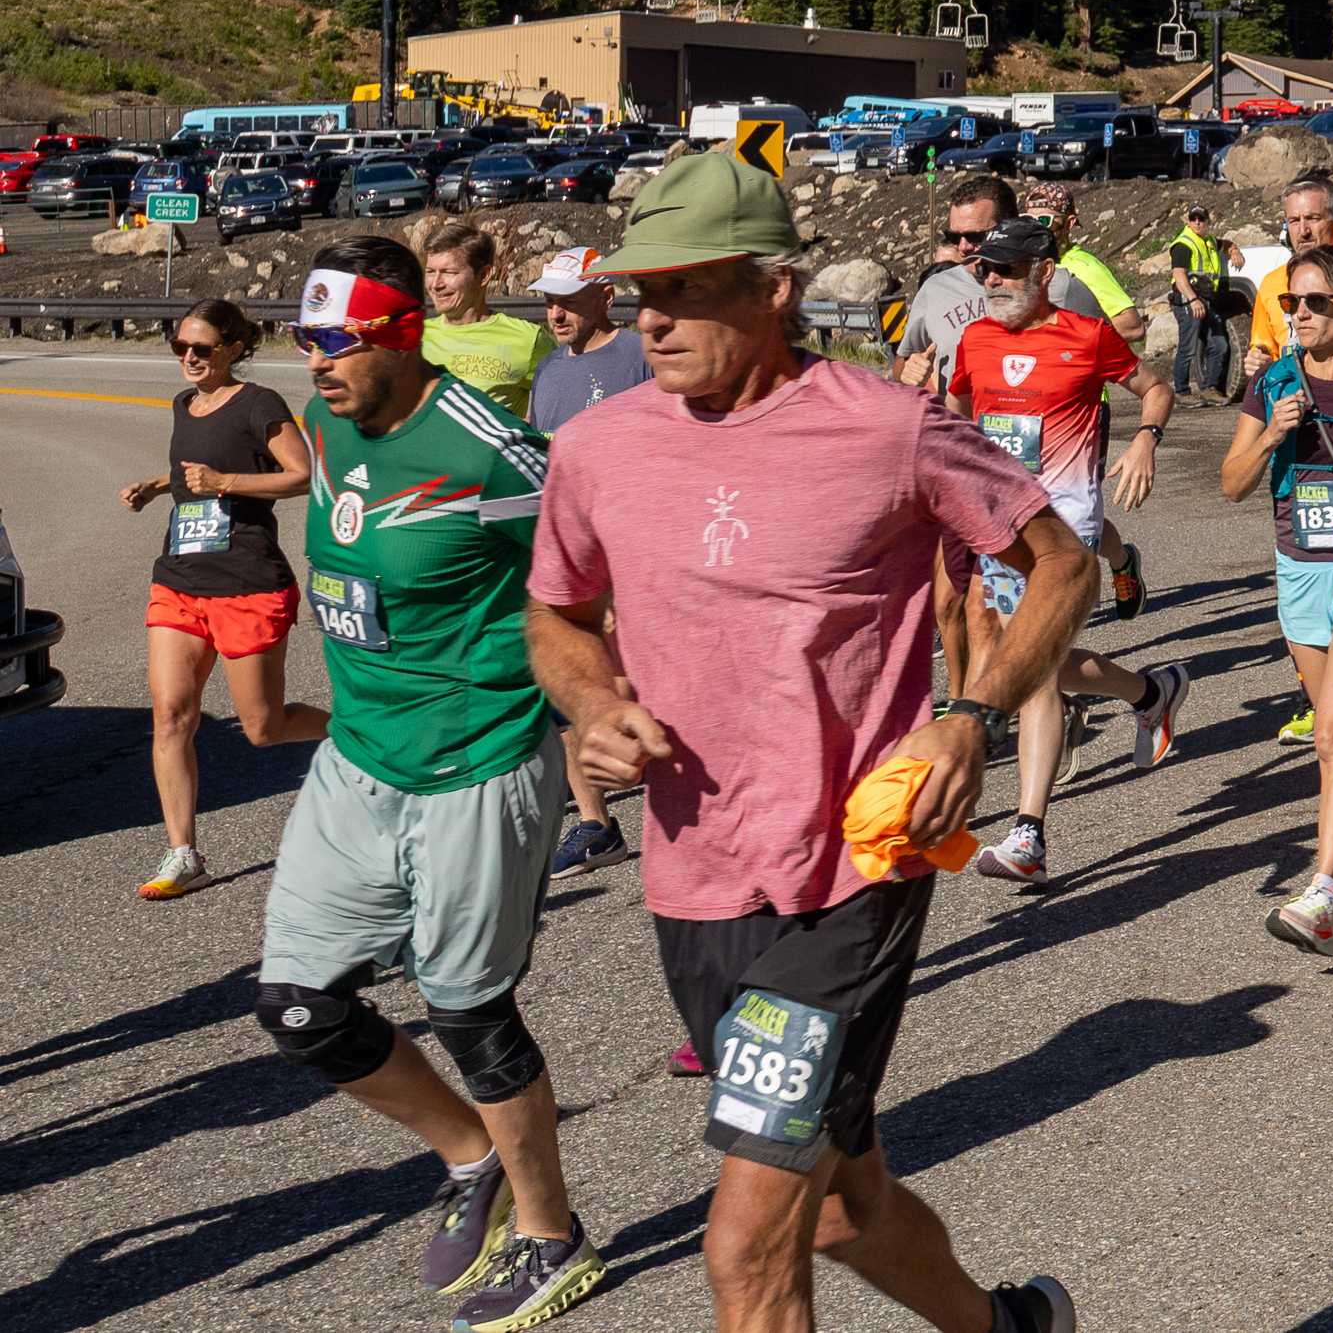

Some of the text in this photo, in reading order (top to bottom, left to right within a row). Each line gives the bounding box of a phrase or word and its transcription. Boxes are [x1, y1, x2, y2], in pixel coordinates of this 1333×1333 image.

[155, 199, 190, 207] CLEAR
[155, 208, 189, 217] CREEK
[943, 297, 988, 330] TEXA
[455, 363, 513, 382] CLASSIC
[458, 354, 512, 372] CRIMSON
[983, 416, 1013, 432] SLACKER
[177, 519, 219, 539] 1252
[316, 604, 367, 641] 1461
[718, 1037, 814, 1102] 1583
